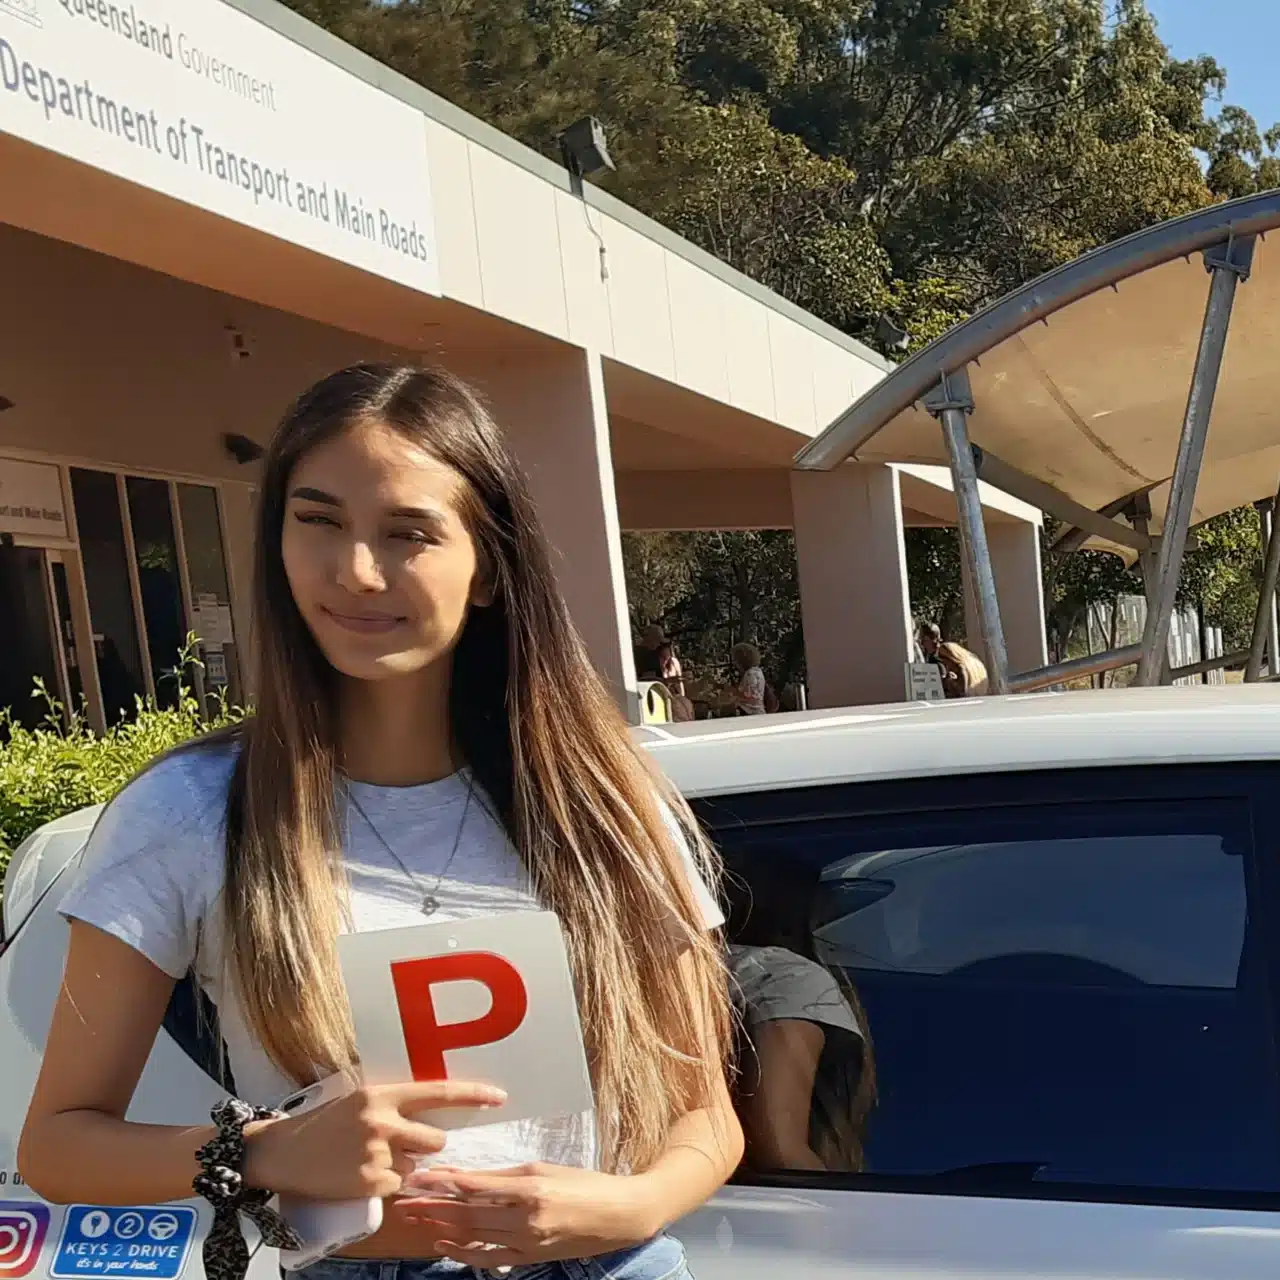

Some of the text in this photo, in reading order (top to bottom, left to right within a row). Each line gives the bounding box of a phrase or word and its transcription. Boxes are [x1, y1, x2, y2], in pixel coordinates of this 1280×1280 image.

[177, 32, 278, 112] Government
[0, 37, 428, 262] Department of Transport and Main Roads
[390, 950, 528, 1082] P
[65, 1242, 180, 1258] KEYS 2 DRIVE
[103, 1261, 129, 1273] your
